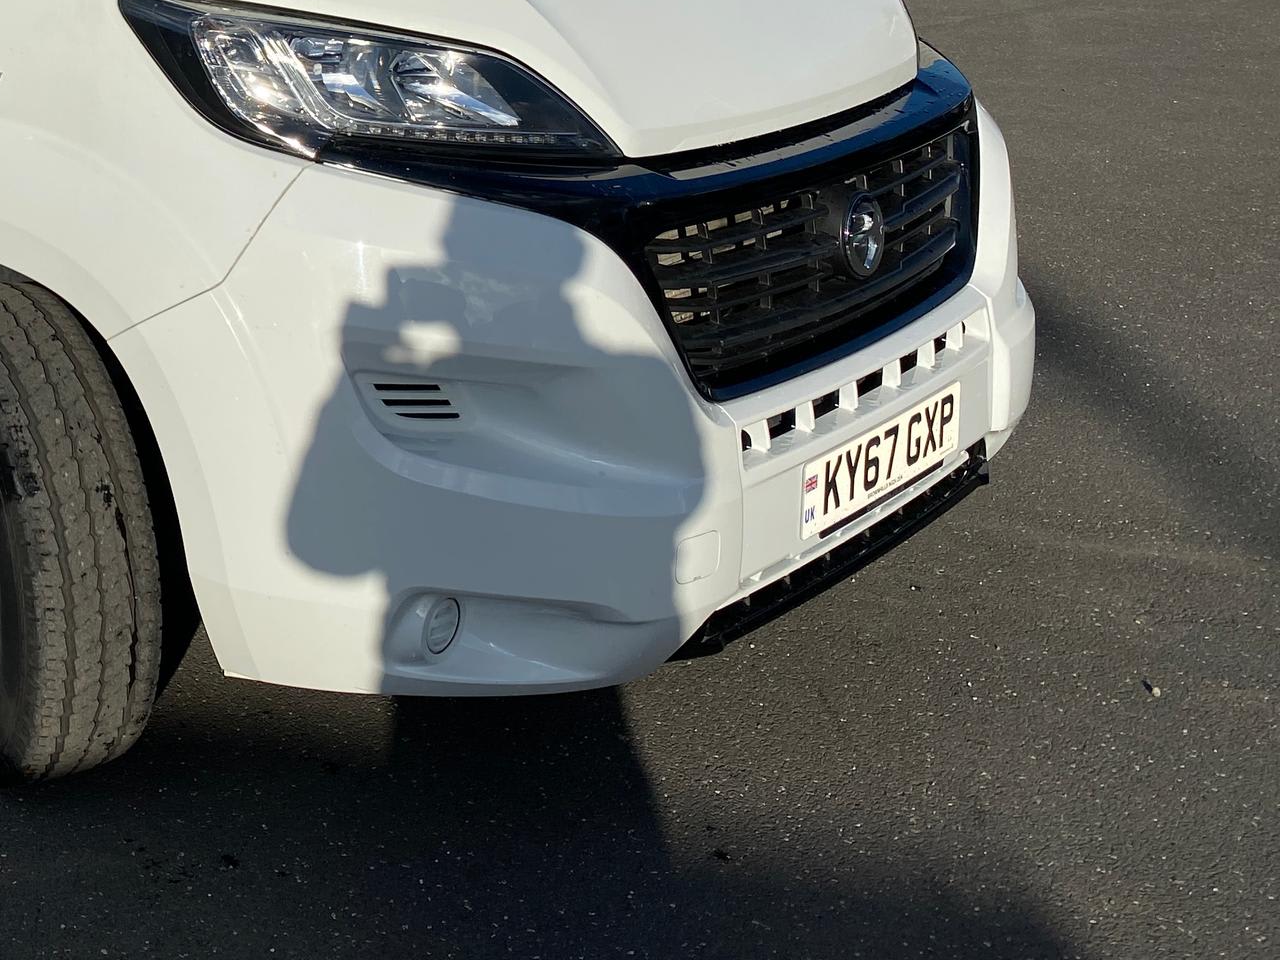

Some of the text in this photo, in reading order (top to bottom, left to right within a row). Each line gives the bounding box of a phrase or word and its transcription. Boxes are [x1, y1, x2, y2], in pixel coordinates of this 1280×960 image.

[823, 393, 954, 516] KY67 GXP
[804, 505, 815, 524] UK
